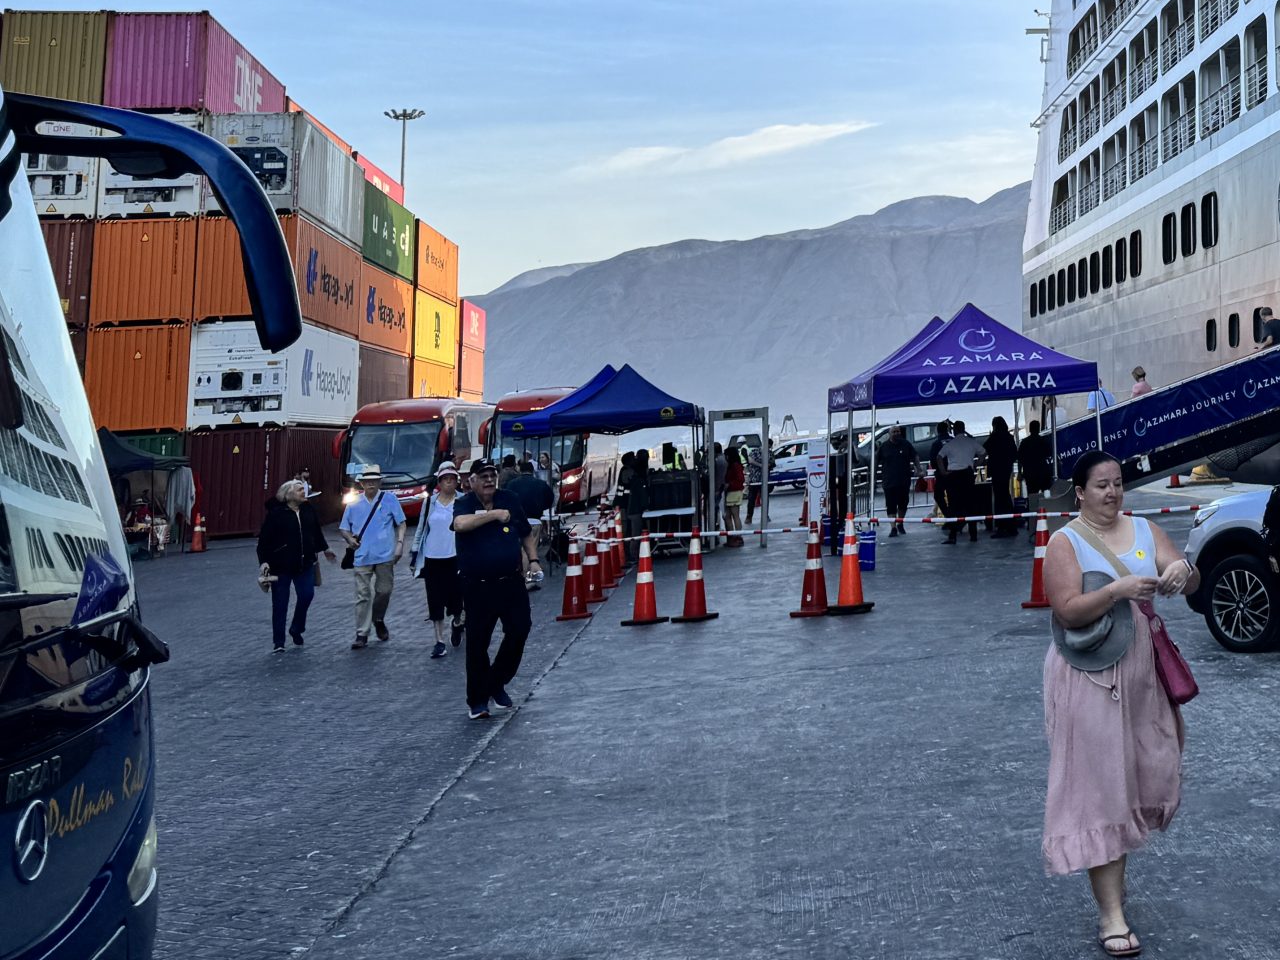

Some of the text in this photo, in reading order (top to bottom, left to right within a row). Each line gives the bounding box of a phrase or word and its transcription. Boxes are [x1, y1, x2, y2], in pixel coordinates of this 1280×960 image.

[922, 351, 1043, 367] AZAMARA
[943, 372, 1057, 394] AZAMARA
[1084, 428, 1127, 451] JORNEY
[1147, 407, 1187, 428] AZAMARA
[1191, 390, 1237, 413] JOURNEY
